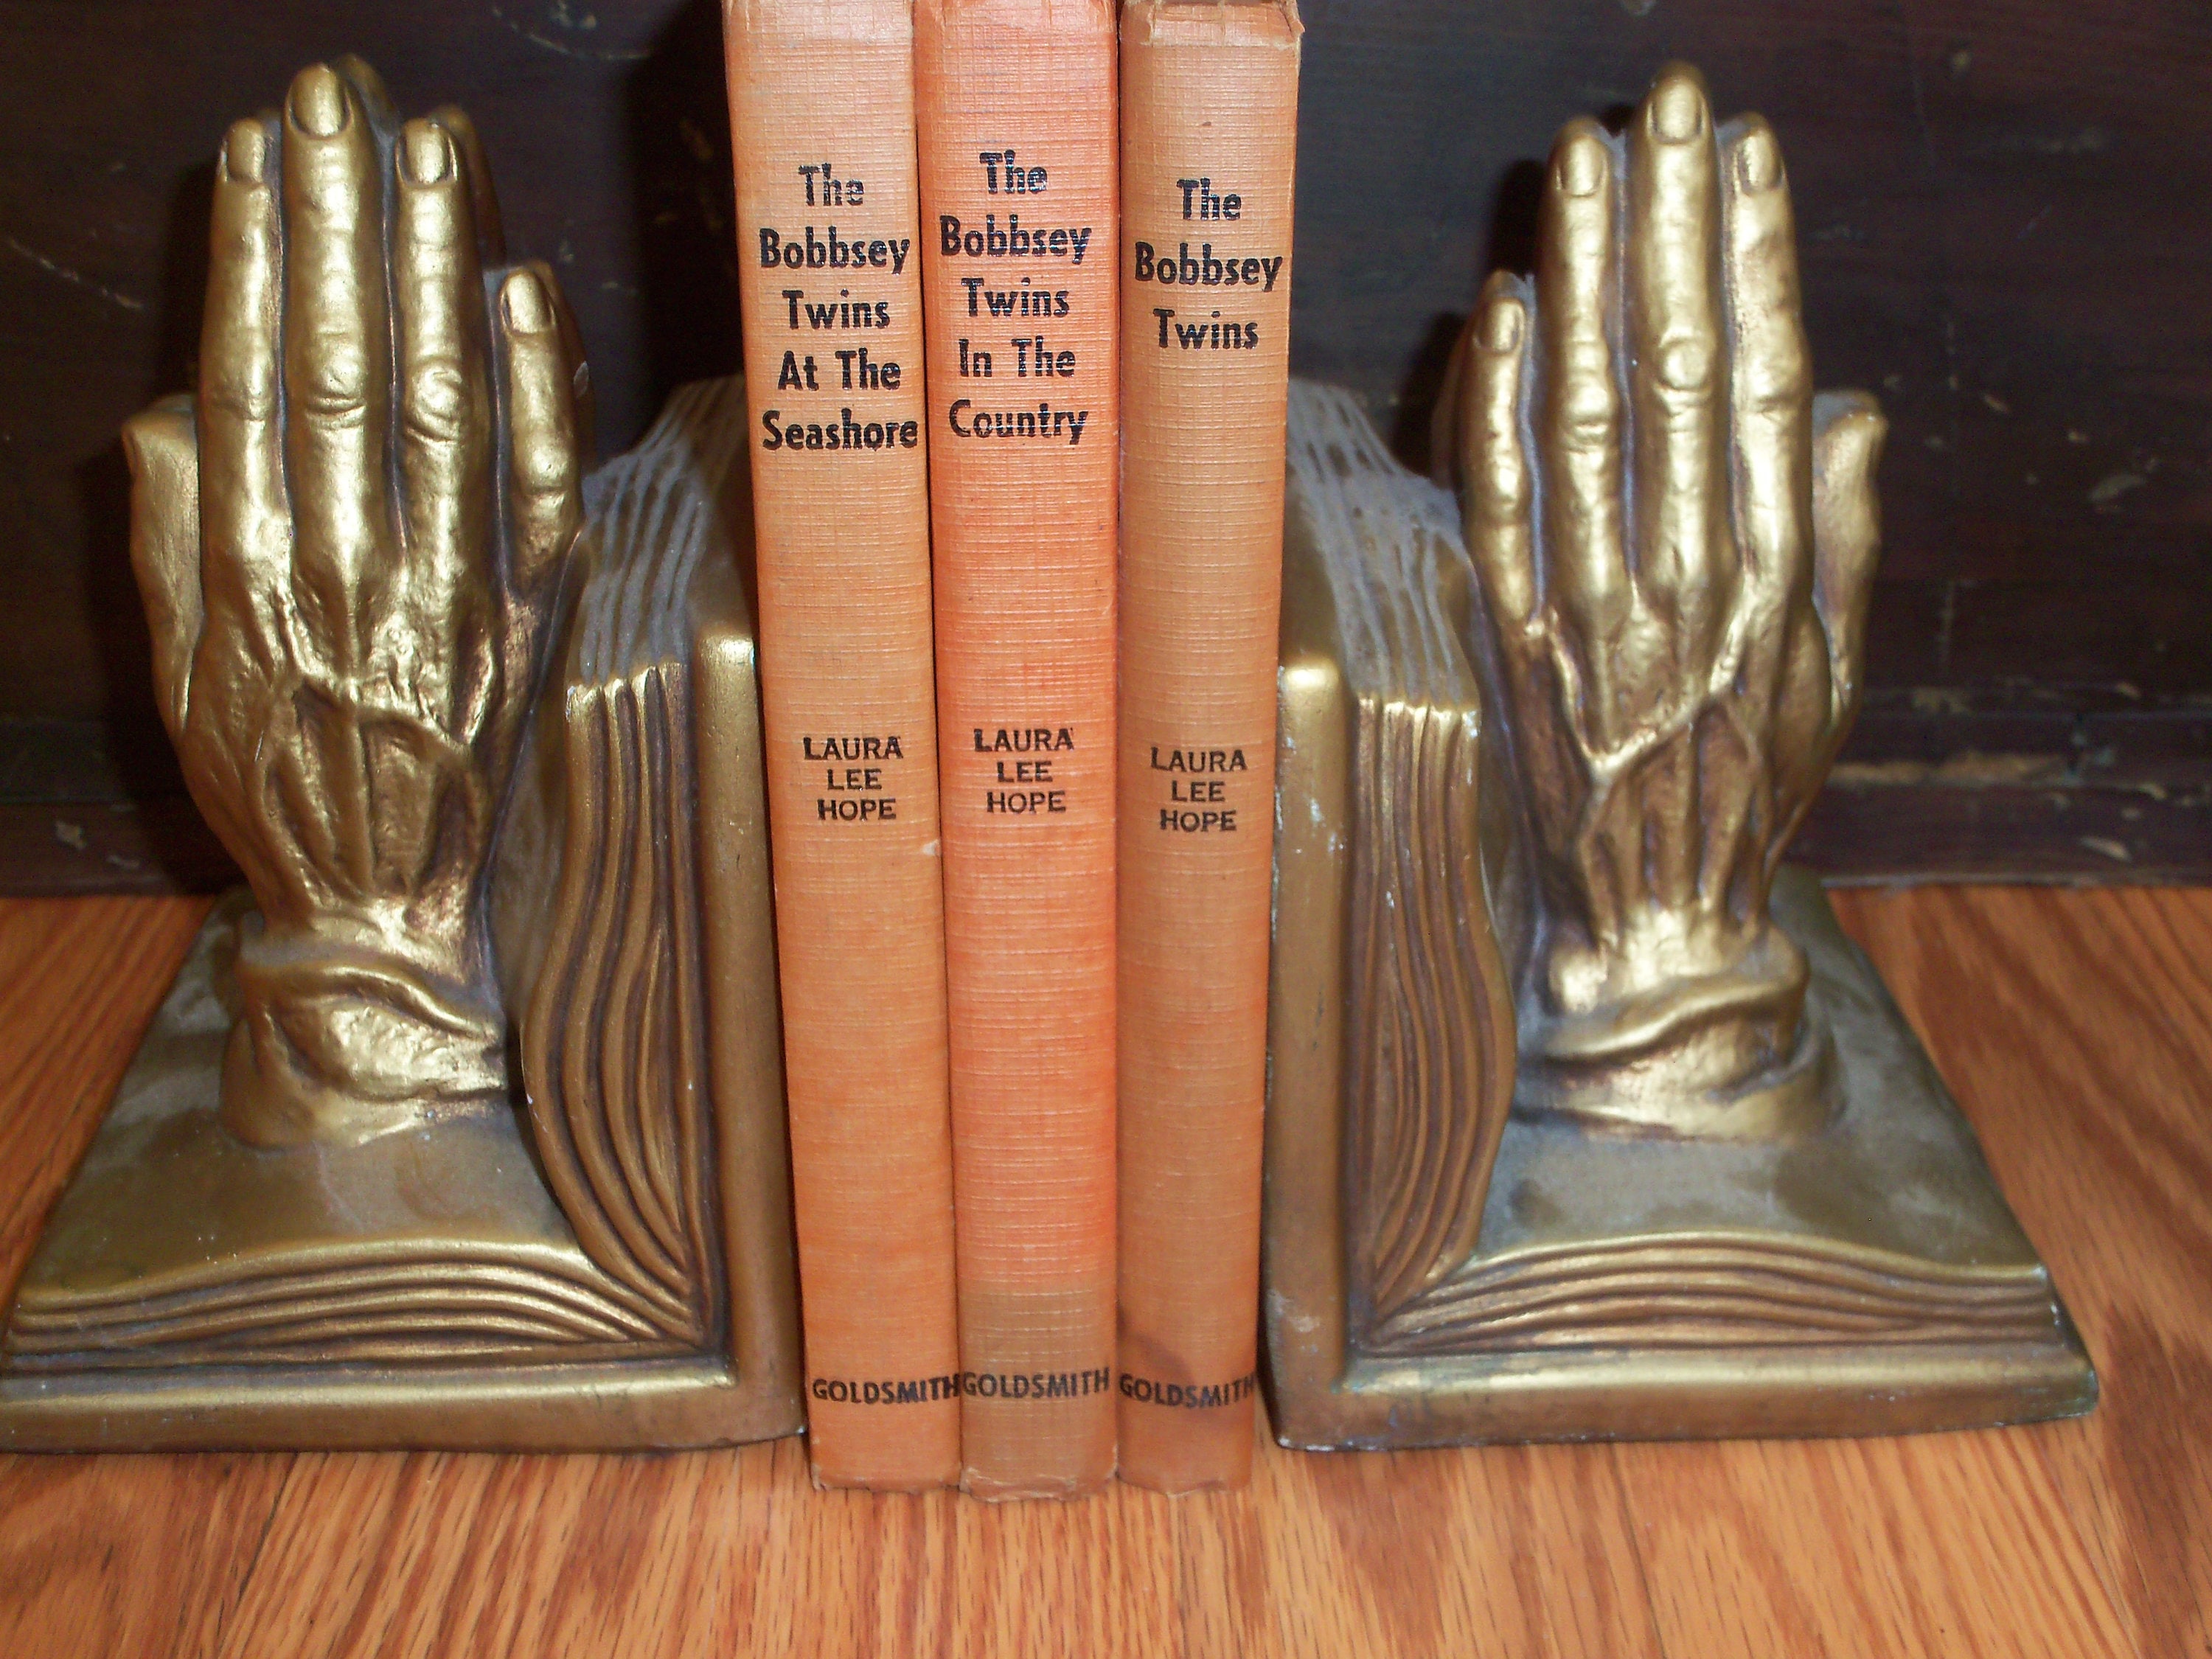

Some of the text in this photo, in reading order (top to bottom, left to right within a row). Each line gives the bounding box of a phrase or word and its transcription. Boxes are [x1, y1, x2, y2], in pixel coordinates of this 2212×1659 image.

[799, 162, 864, 206] The
[980, 150, 1048, 195] The
[1177, 177, 1242, 220] The
[759, 226, 911, 275] Bobbsey
[939, 214, 1092, 265] Bobbsey
[1135, 241, 1283, 292] Bobbsey
[782, 288, 891, 330] Twins
[961, 277, 1070, 318] Twins
[1152, 307, 1259, 349] Twins
[777, 347, 901, 391] At The
[959, 335, 1077, 378] In The
[762, 407, 918, 451] Seashore
[948, 399, 1088, 445] Country
[803, 736, 903, 760] LAURA
[973, 728, 1075, 753] LAURA
[1150, 745, 1248, 773] LAURA
[827, 768, 882, 791] LEE
[996, 761, 1053, 783] LEE
[1171, 779, 1225, 802] LEE
[817, 798, 896, 821] HOPE
[986, 790, 1066, 814] HOPE
[1159, 809, 1237, 832] HOPE
[813, 1373, 960, 1404] GOLDSMITH
[962, 1367, 1110, 1399] GOLDSMITH
[1119, 1371, 1255, 1409] GOLDSMITH
